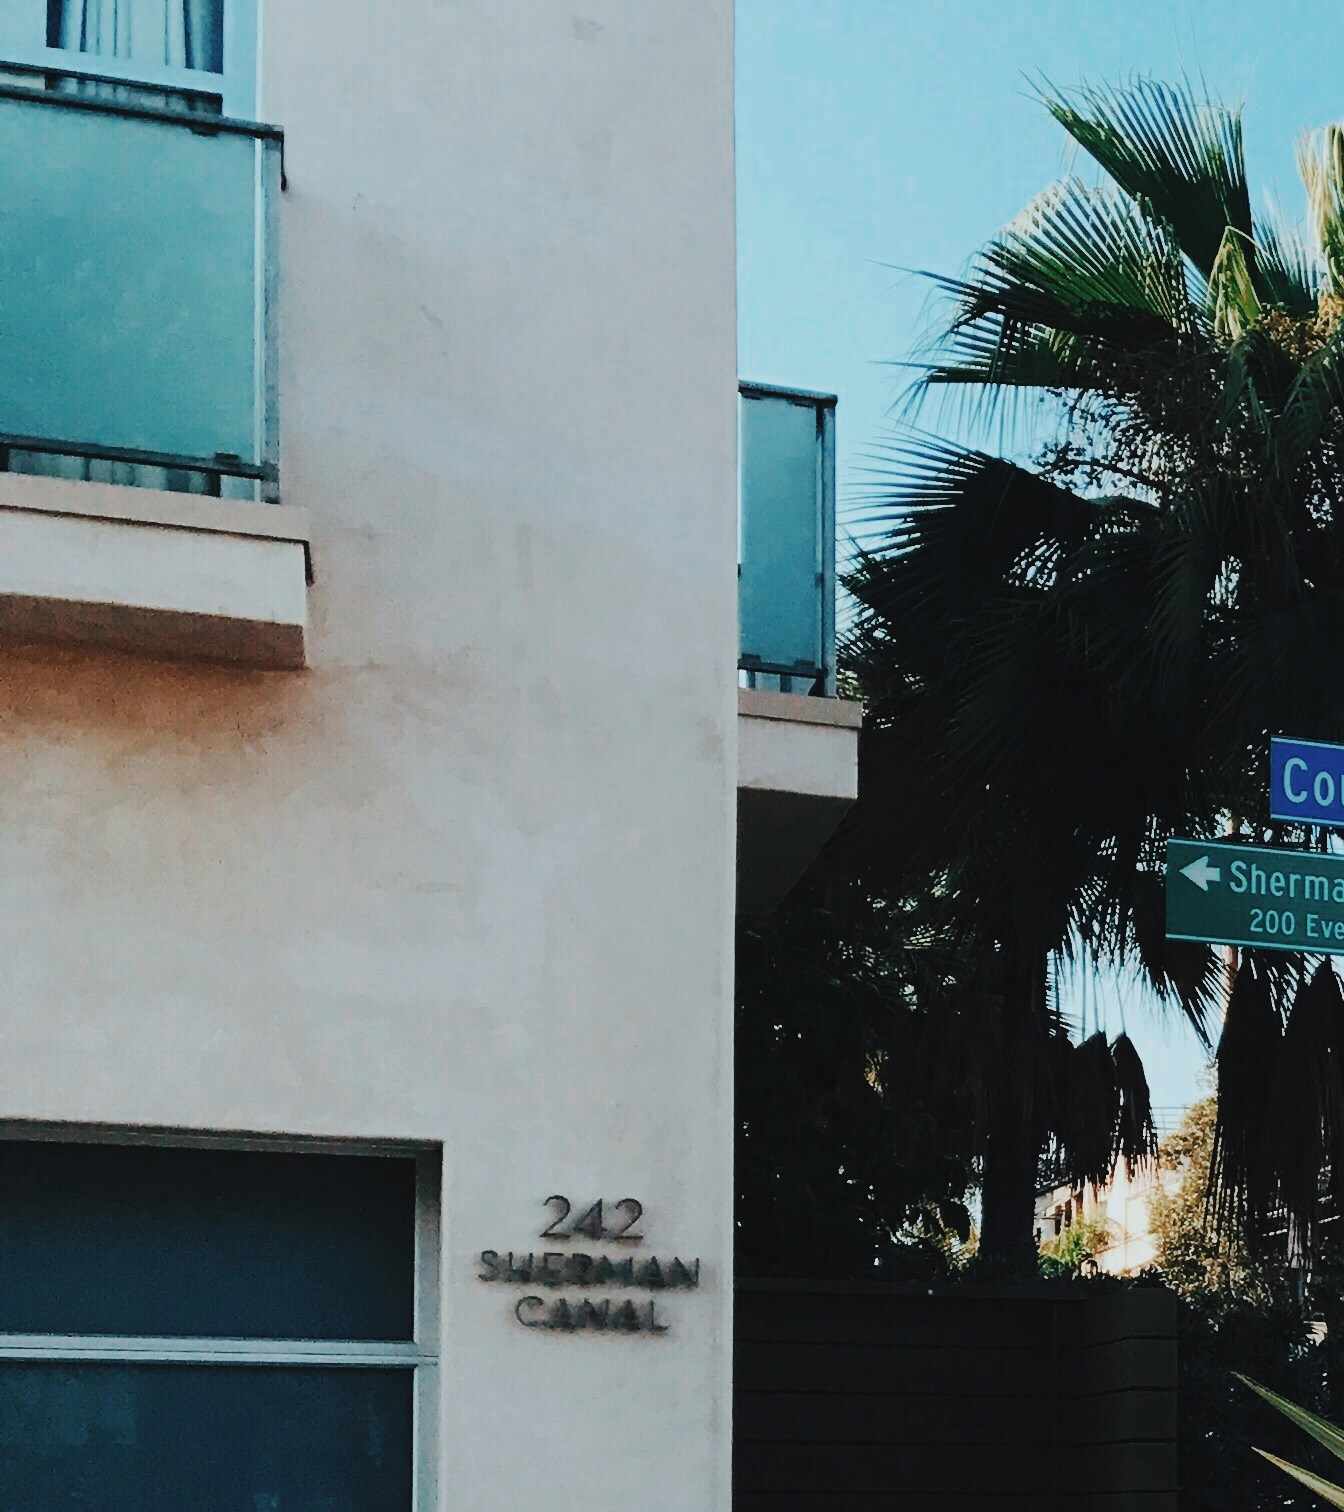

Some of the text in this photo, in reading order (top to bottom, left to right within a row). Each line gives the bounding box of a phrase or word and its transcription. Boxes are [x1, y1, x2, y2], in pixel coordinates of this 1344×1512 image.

[1249, 909, 1295, 936] 200
[540, 1195, 644, 1240] 242
[478, 1250, 699, 1288] SHERMAN
[515, 1295, 668, 1331] CANAL
